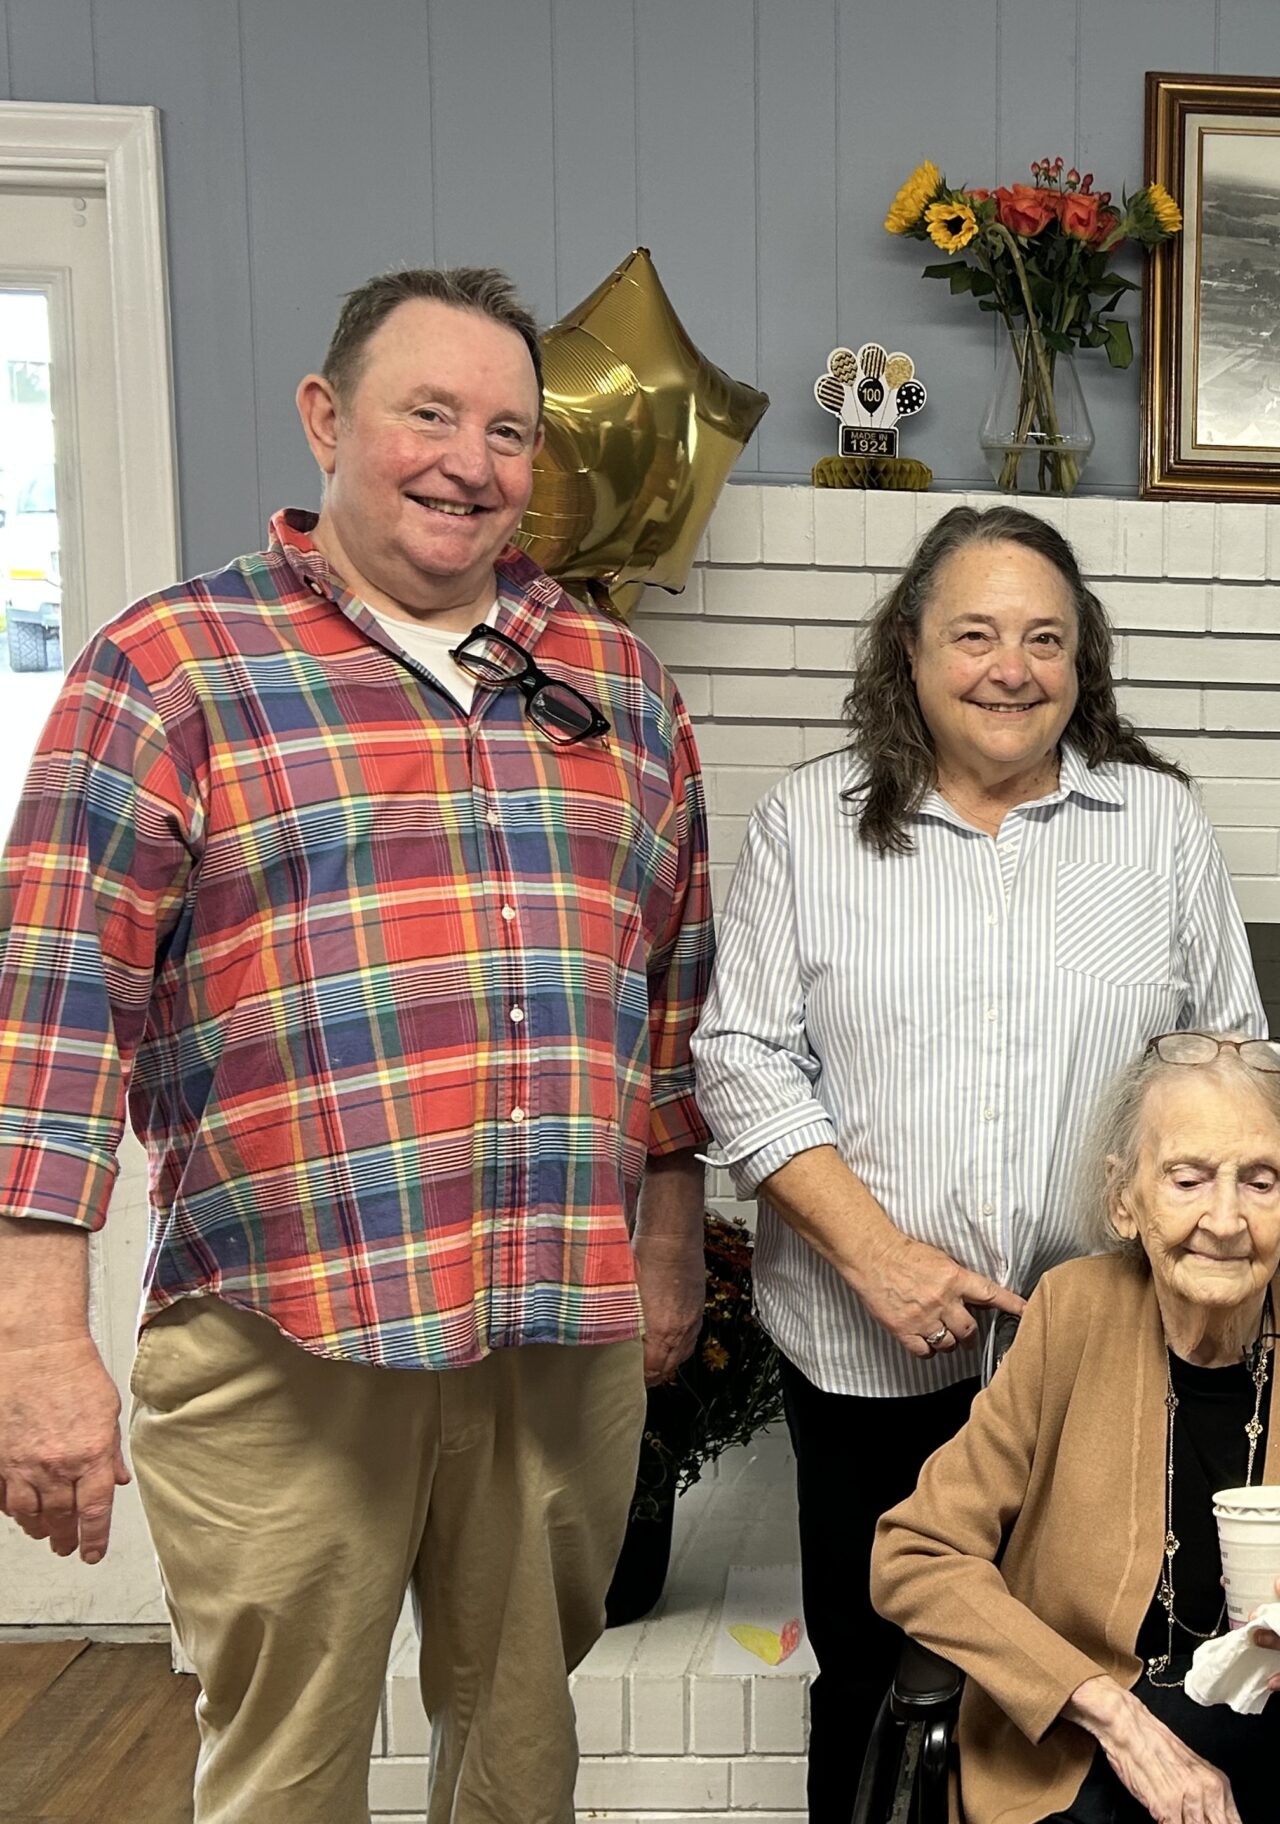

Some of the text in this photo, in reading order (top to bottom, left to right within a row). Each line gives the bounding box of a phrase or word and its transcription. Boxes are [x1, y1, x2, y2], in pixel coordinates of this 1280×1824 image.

[862, 388, 881, 402] 100
[851, 432, 888, 441] MADE IN
[850, 439, 888, 453] 1924
